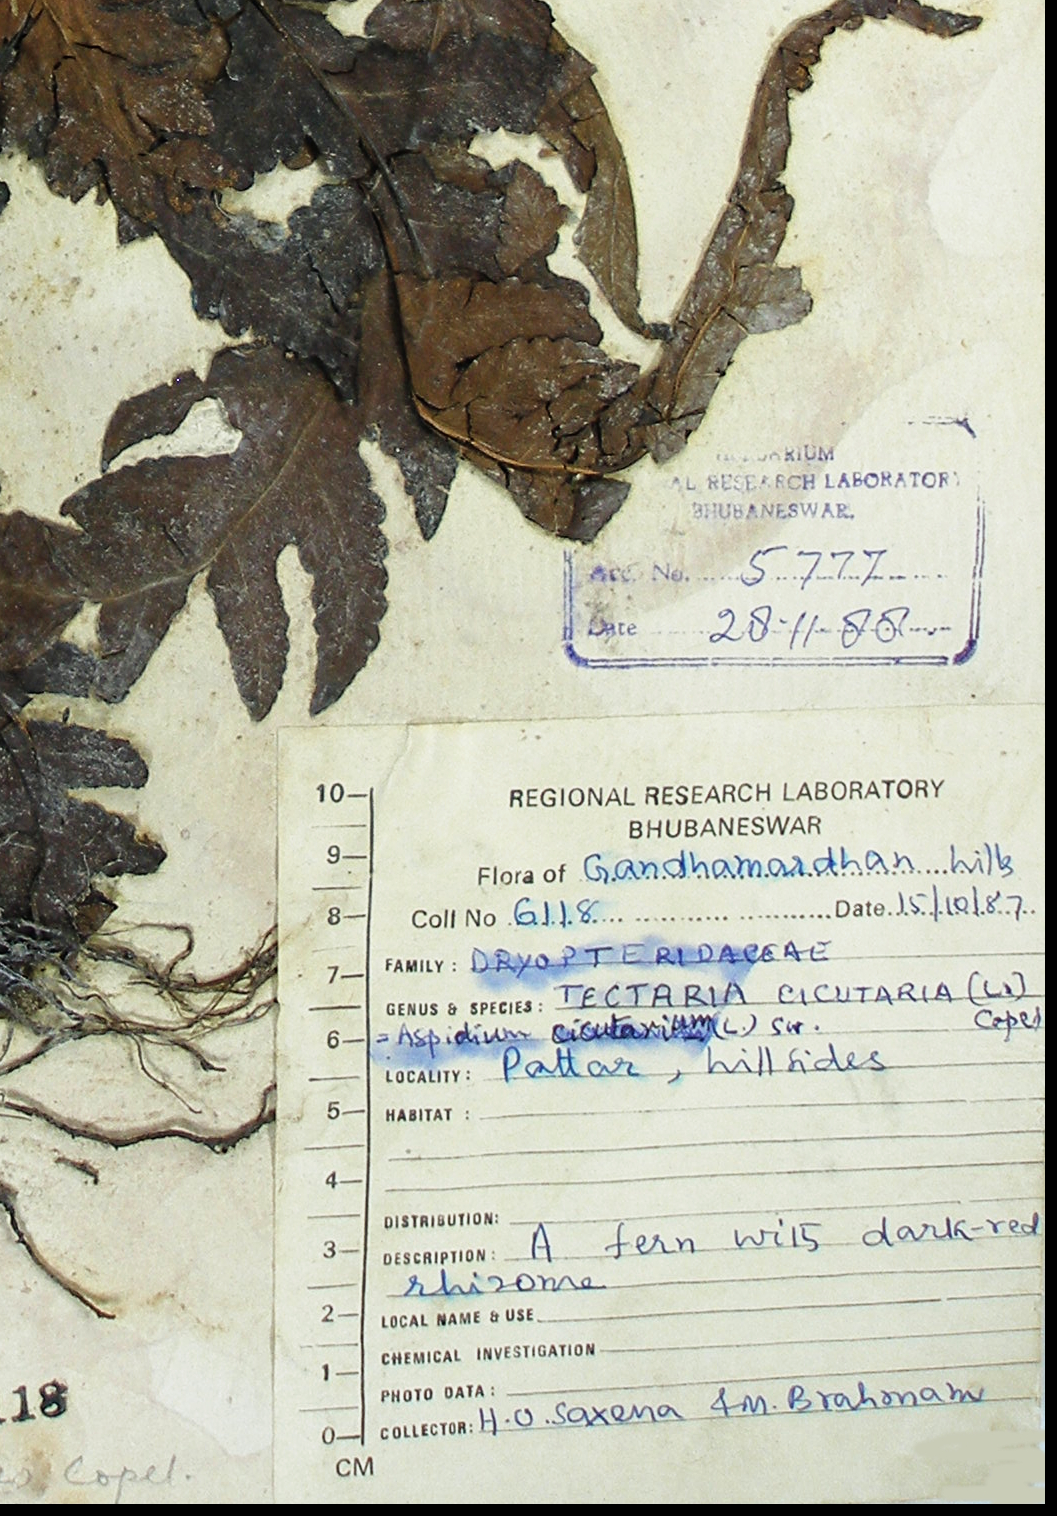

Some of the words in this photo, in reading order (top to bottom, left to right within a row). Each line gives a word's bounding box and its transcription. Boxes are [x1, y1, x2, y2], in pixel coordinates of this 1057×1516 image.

[716, 445, 836, 463] ARIUM
[707, 472, 817, 491] RESEARCH
[740, 544, 888, 591] 5777
[588, 618, 639, 638] Date
[316, 783, 344, 804] 10
[509, 787, 636, 808] REGIONAL
[644, 782, 772, 806] RESEARCH
[783, 779, 945, 802] LABORATORY
[629, 816, 822, 839] BHUBANESWAR
[327, 845, 341, 865] 9
[477, 865, 535, 886] Flora
[543, 863, 567, 884] of
[327, 907, 342, 927] 8
[412, 909, 457, 930] Coll
[465, 908, 497, 928] No
[513, 897, 600, 929] 6118
[835, 900, 886, 919] Date
[327, 966, 340, 985] 7
[386, 1002, 439, 1017] GENUS
[448, 1001, 458, 1016] &
[554, 981, 747, 1010] TECTARIA
[777, 982, 953, 1007] CICUTARIA
[327, 1031, 341, 1050] 6
[327, 1102, 341, 1121] 5
[325, 1171, 338, 1189] 4
[384, 1212, 499, 1230] DISTRIBUTION:
[323, 1240, 337, 1259] 3
[531, 1222, 552, 1263] A
[605, 1222, 696, 1260] fern
[321, 1305, 335, 1324] 2
[381, 1314, 429, 1330] LOCAL
[436, 1311, 482, 1327] NAME
[490, 1310, 500, 1324] &
[505, 1309, 535, 1323] USE
[381, 1349, 462, 1366] CHEMICAL
[476, 1343, 597, 1362] INVESTIGATION
[321, 1363, 331, 1382] 1
[381, 1388, 434, 1404] PHOTO
[322, 1427, 335, 1445] 0
[381, 1422, 474, 1441] COLLECTOR:
[335, 1456, 375, 1478] CM
